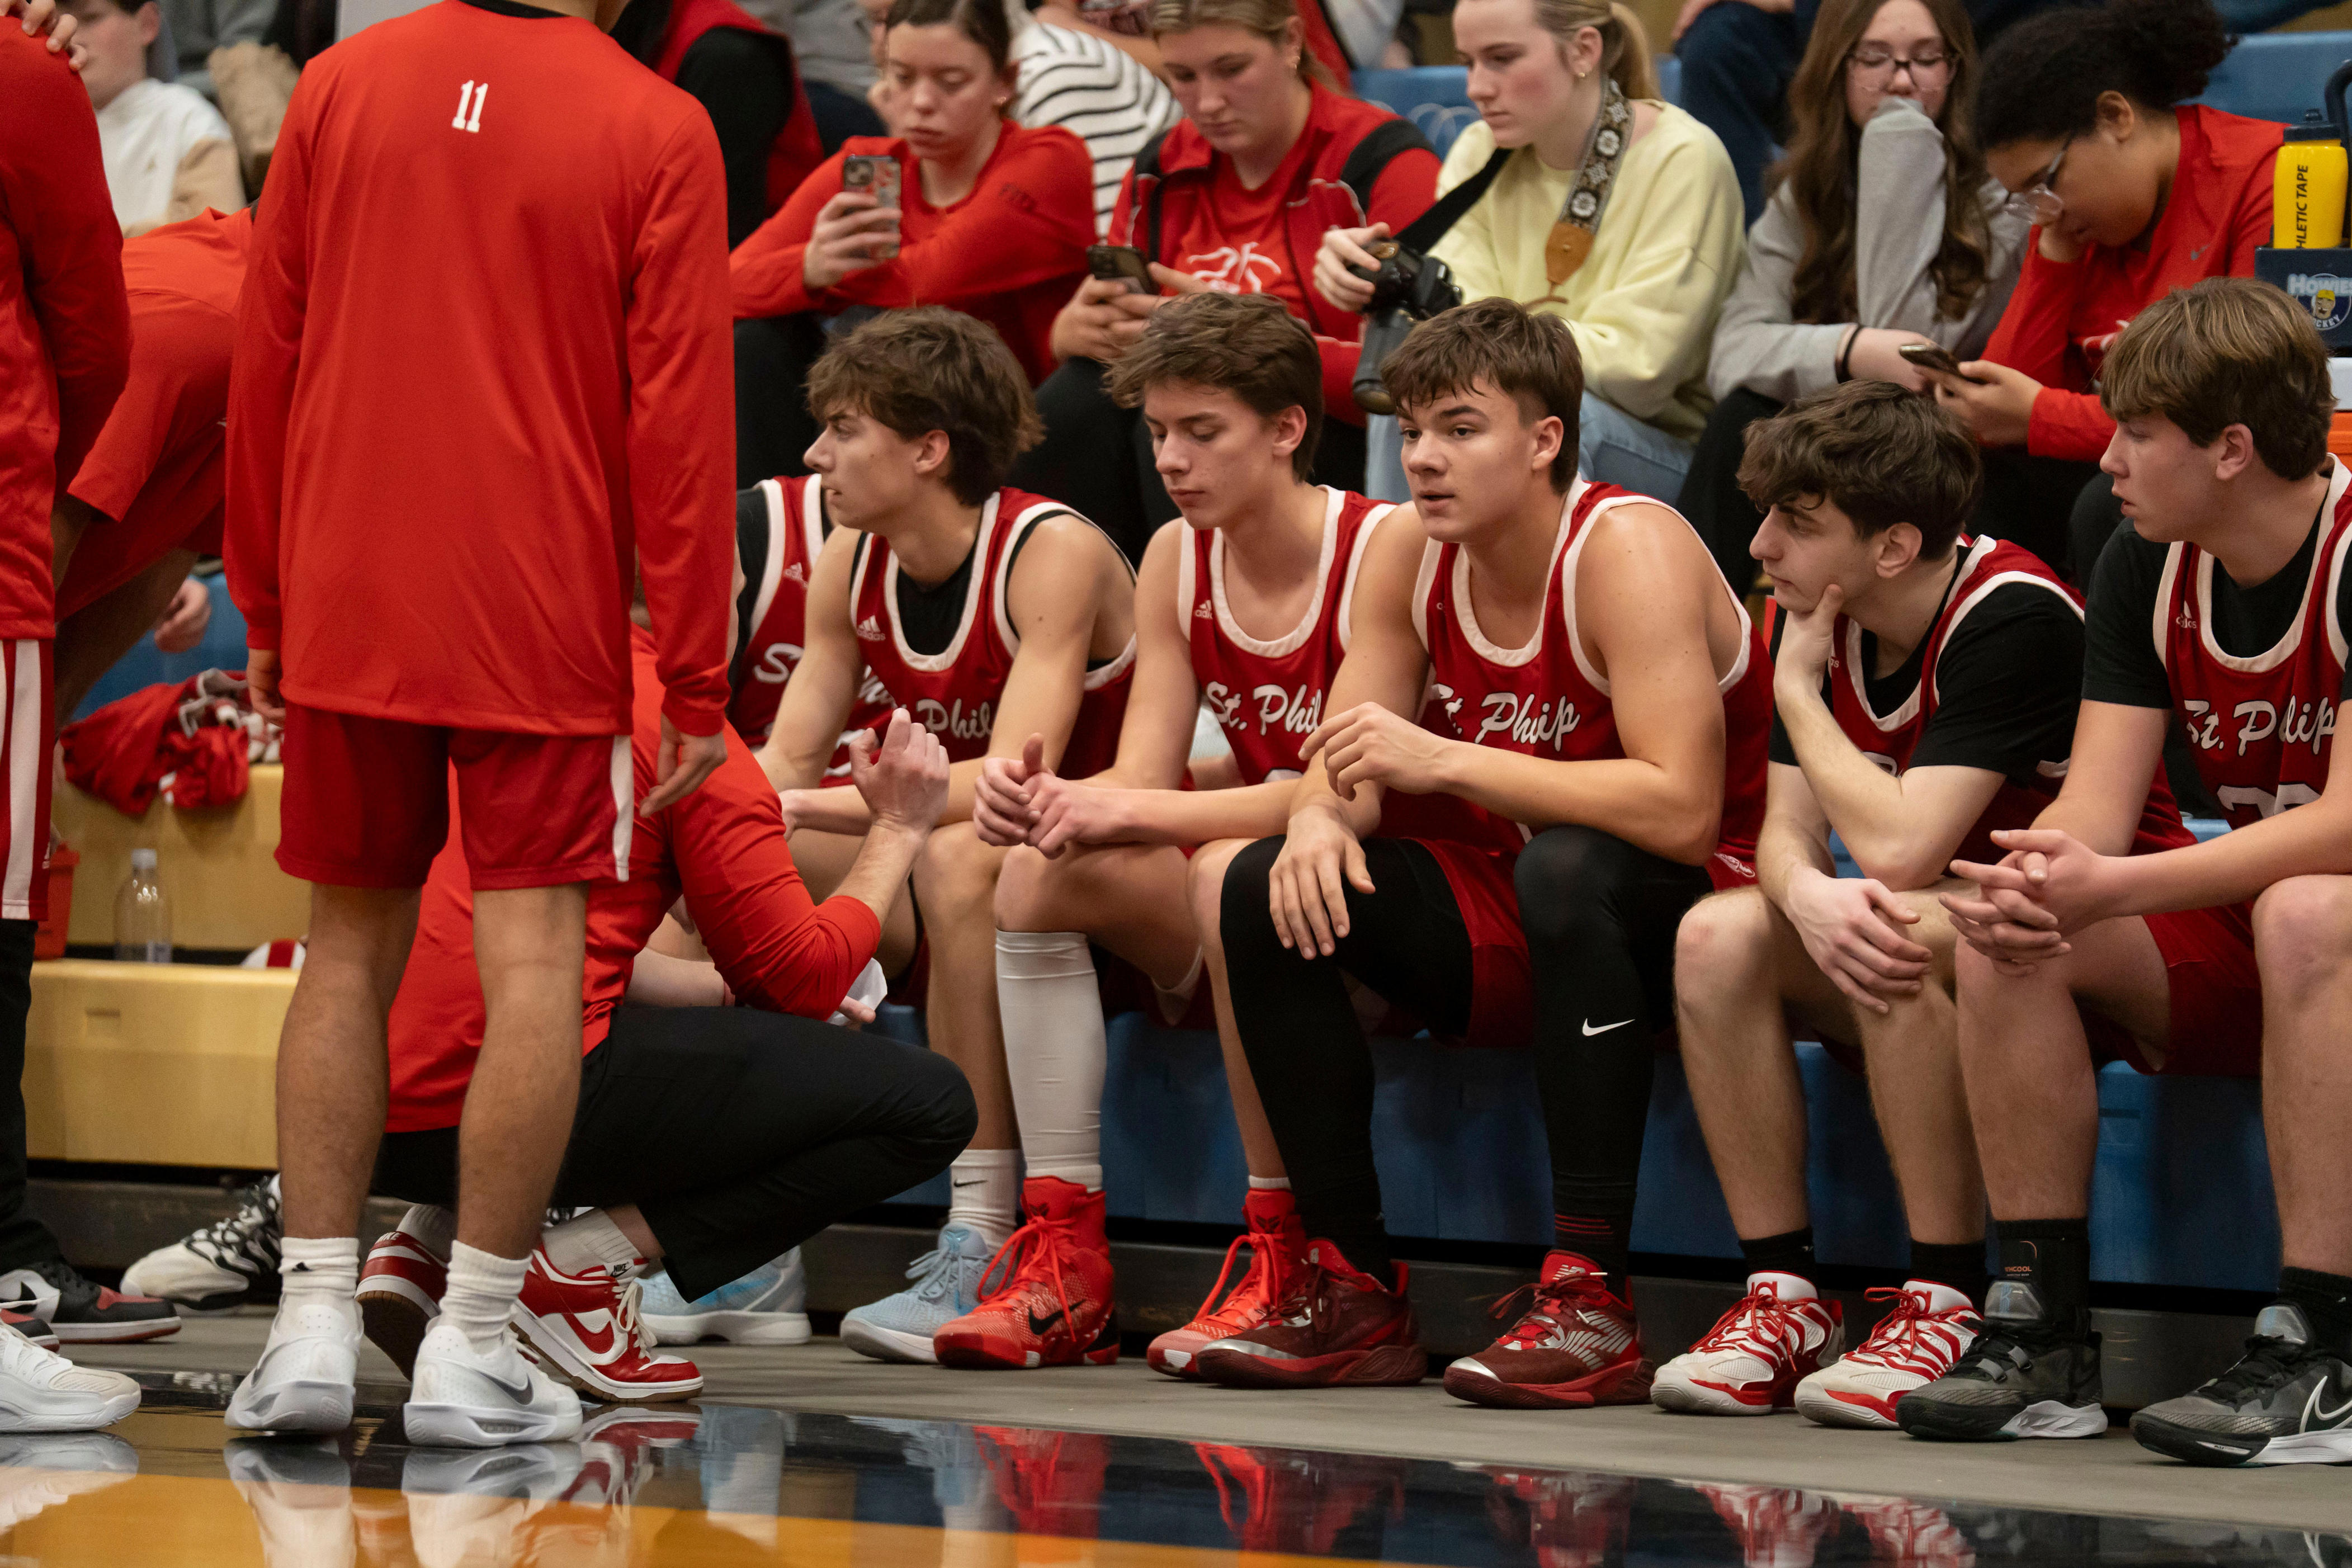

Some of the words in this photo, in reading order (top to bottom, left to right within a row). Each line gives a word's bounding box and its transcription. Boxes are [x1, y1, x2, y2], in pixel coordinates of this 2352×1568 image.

[452, 79, 488, 133] 11
[2297, 164, 2308, 199] TAPE
[2288, 274, 2352, 296] HOWIE
[1207, 681, 1247, 730] St.
[613, 1263, 627, 1272] NIKE
